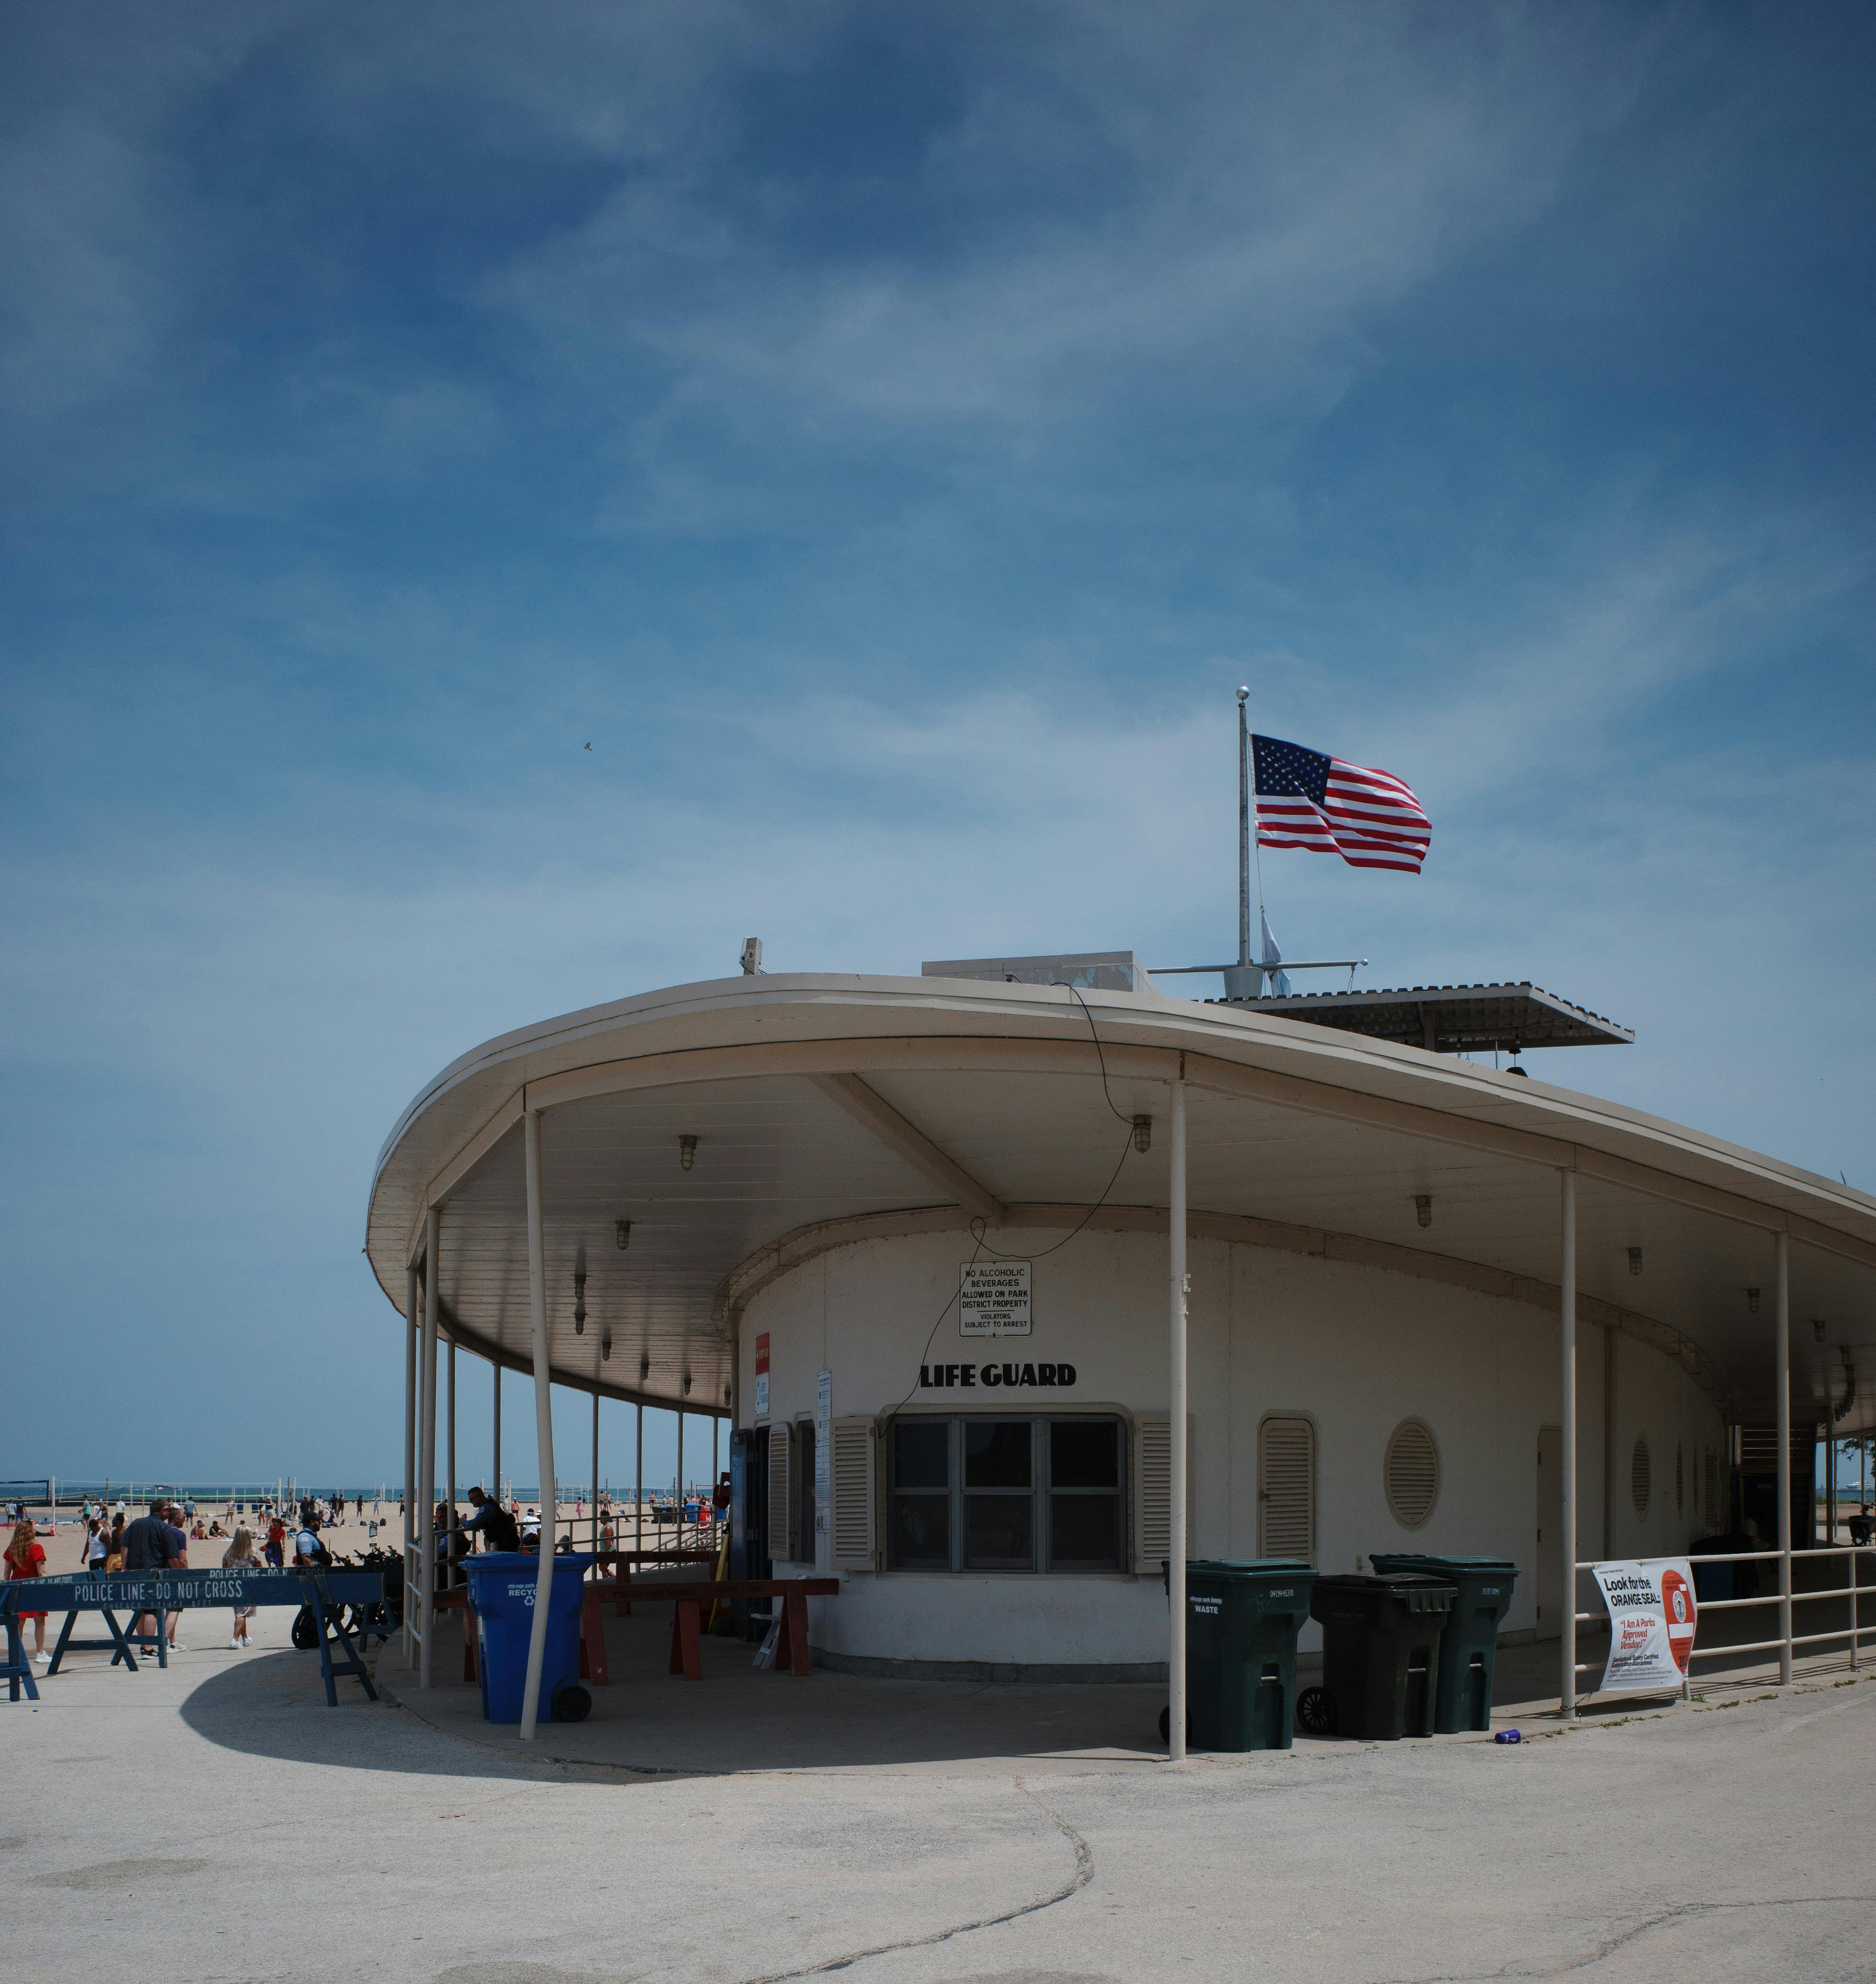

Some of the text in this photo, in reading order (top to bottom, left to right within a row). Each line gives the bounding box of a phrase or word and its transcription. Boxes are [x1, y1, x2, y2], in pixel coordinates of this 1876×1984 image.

[980, 1269, 1025, 1277] ALCOHOLIC
[971, 1279, 1019, 1288] BEVERAGES
[962, 1290, 992, 1298] ALLOWED
[920, 1363, 1076, 1387] LIFE GUARD
[210, 1569, 238, 1579] POLICE
[1604, 1576, 1651, 1591] Look for the
[75, 1584, 114, 1601] POLICE
[178, 1581, 199, 1599] NOT
[205, 1580, 242, 1598] CROSS
[1611, 1593, 1642, 1607] ORANGE
[1195, 1605, 1218, 1614] WASTE
[1626, 1620, 1635, 1628] Am
[1635, 1619, 1640, 1628] A
[1641, 1618, 1655, 1627] Parks
[1622, 1628, 1647, 1641] Approved
